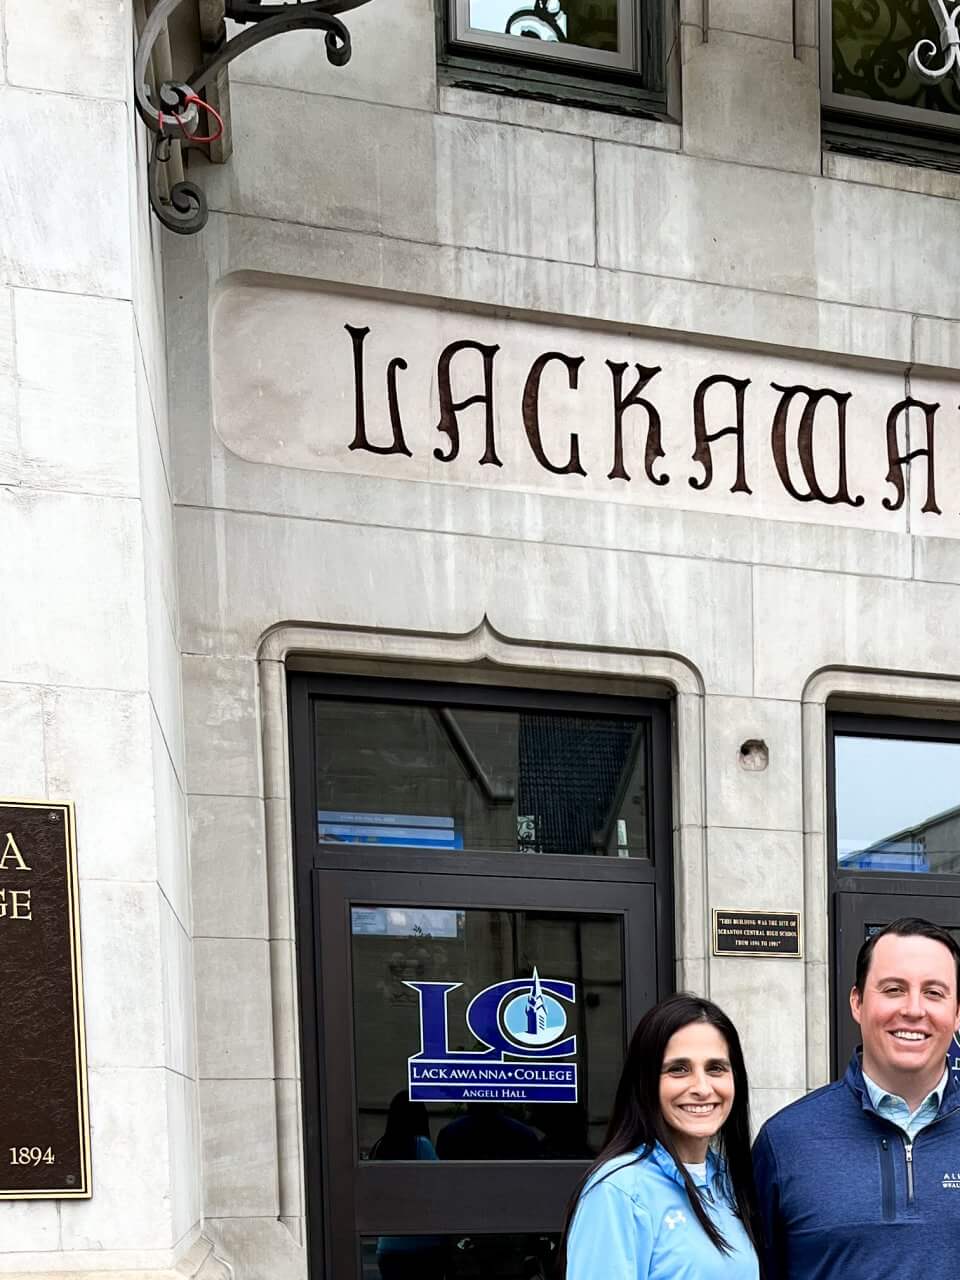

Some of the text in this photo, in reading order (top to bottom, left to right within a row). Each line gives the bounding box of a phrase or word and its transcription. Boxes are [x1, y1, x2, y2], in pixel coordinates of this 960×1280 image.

[412, 1067, 573, 1081] LACKAWANNA COLLEGE
[462, 1088, 527, 1099] ANGELI HALL
[9, 1146, 55, 1167] 1894
